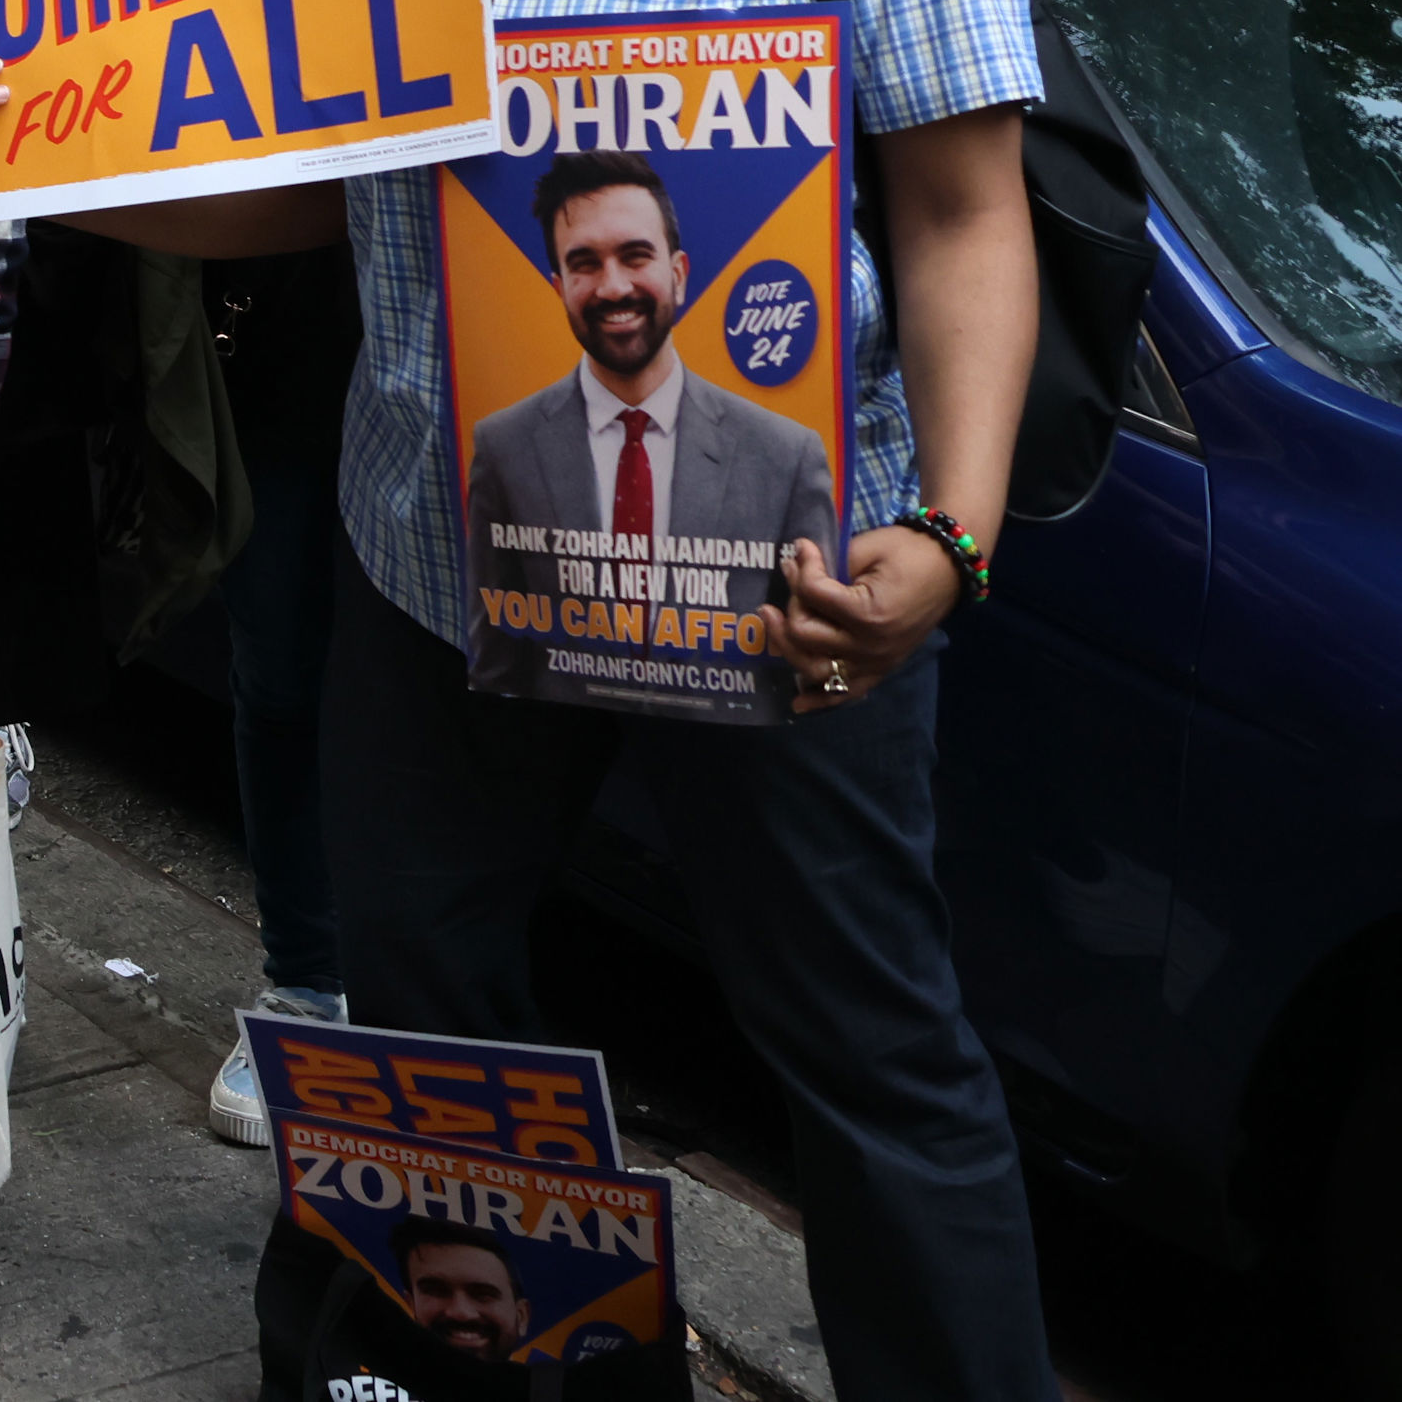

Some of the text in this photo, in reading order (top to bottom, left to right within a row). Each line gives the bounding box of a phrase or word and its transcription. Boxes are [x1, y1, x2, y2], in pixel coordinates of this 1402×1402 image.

[497, 29, 825, 71] OCRAT FOR MAYOR
[6, 59, 132, 165] FOR
[498, 65, 836, 157] OHRAN
[745, 280, 790, 303] VOTE
[727, 301, 808, 336] JUNE
[747, 336, 792, 369] 24
[490, 522, 548, 553] RANK
[552, 528, 649, 560] ZOHRAN
[654, 536, 775, 569] MAMDANI
[558, 559, 729, 607] FOR A NEW YORK
[479, 587, 766, 656] YOU CAN AFFO
[546, 648, 755, 694] ZOHRANFORNYC.COM
[292, 1128, 649, 1212] DEMOCRAT FOR MAYOR
[289, 1146, 660, 1265] ZOHRAN
